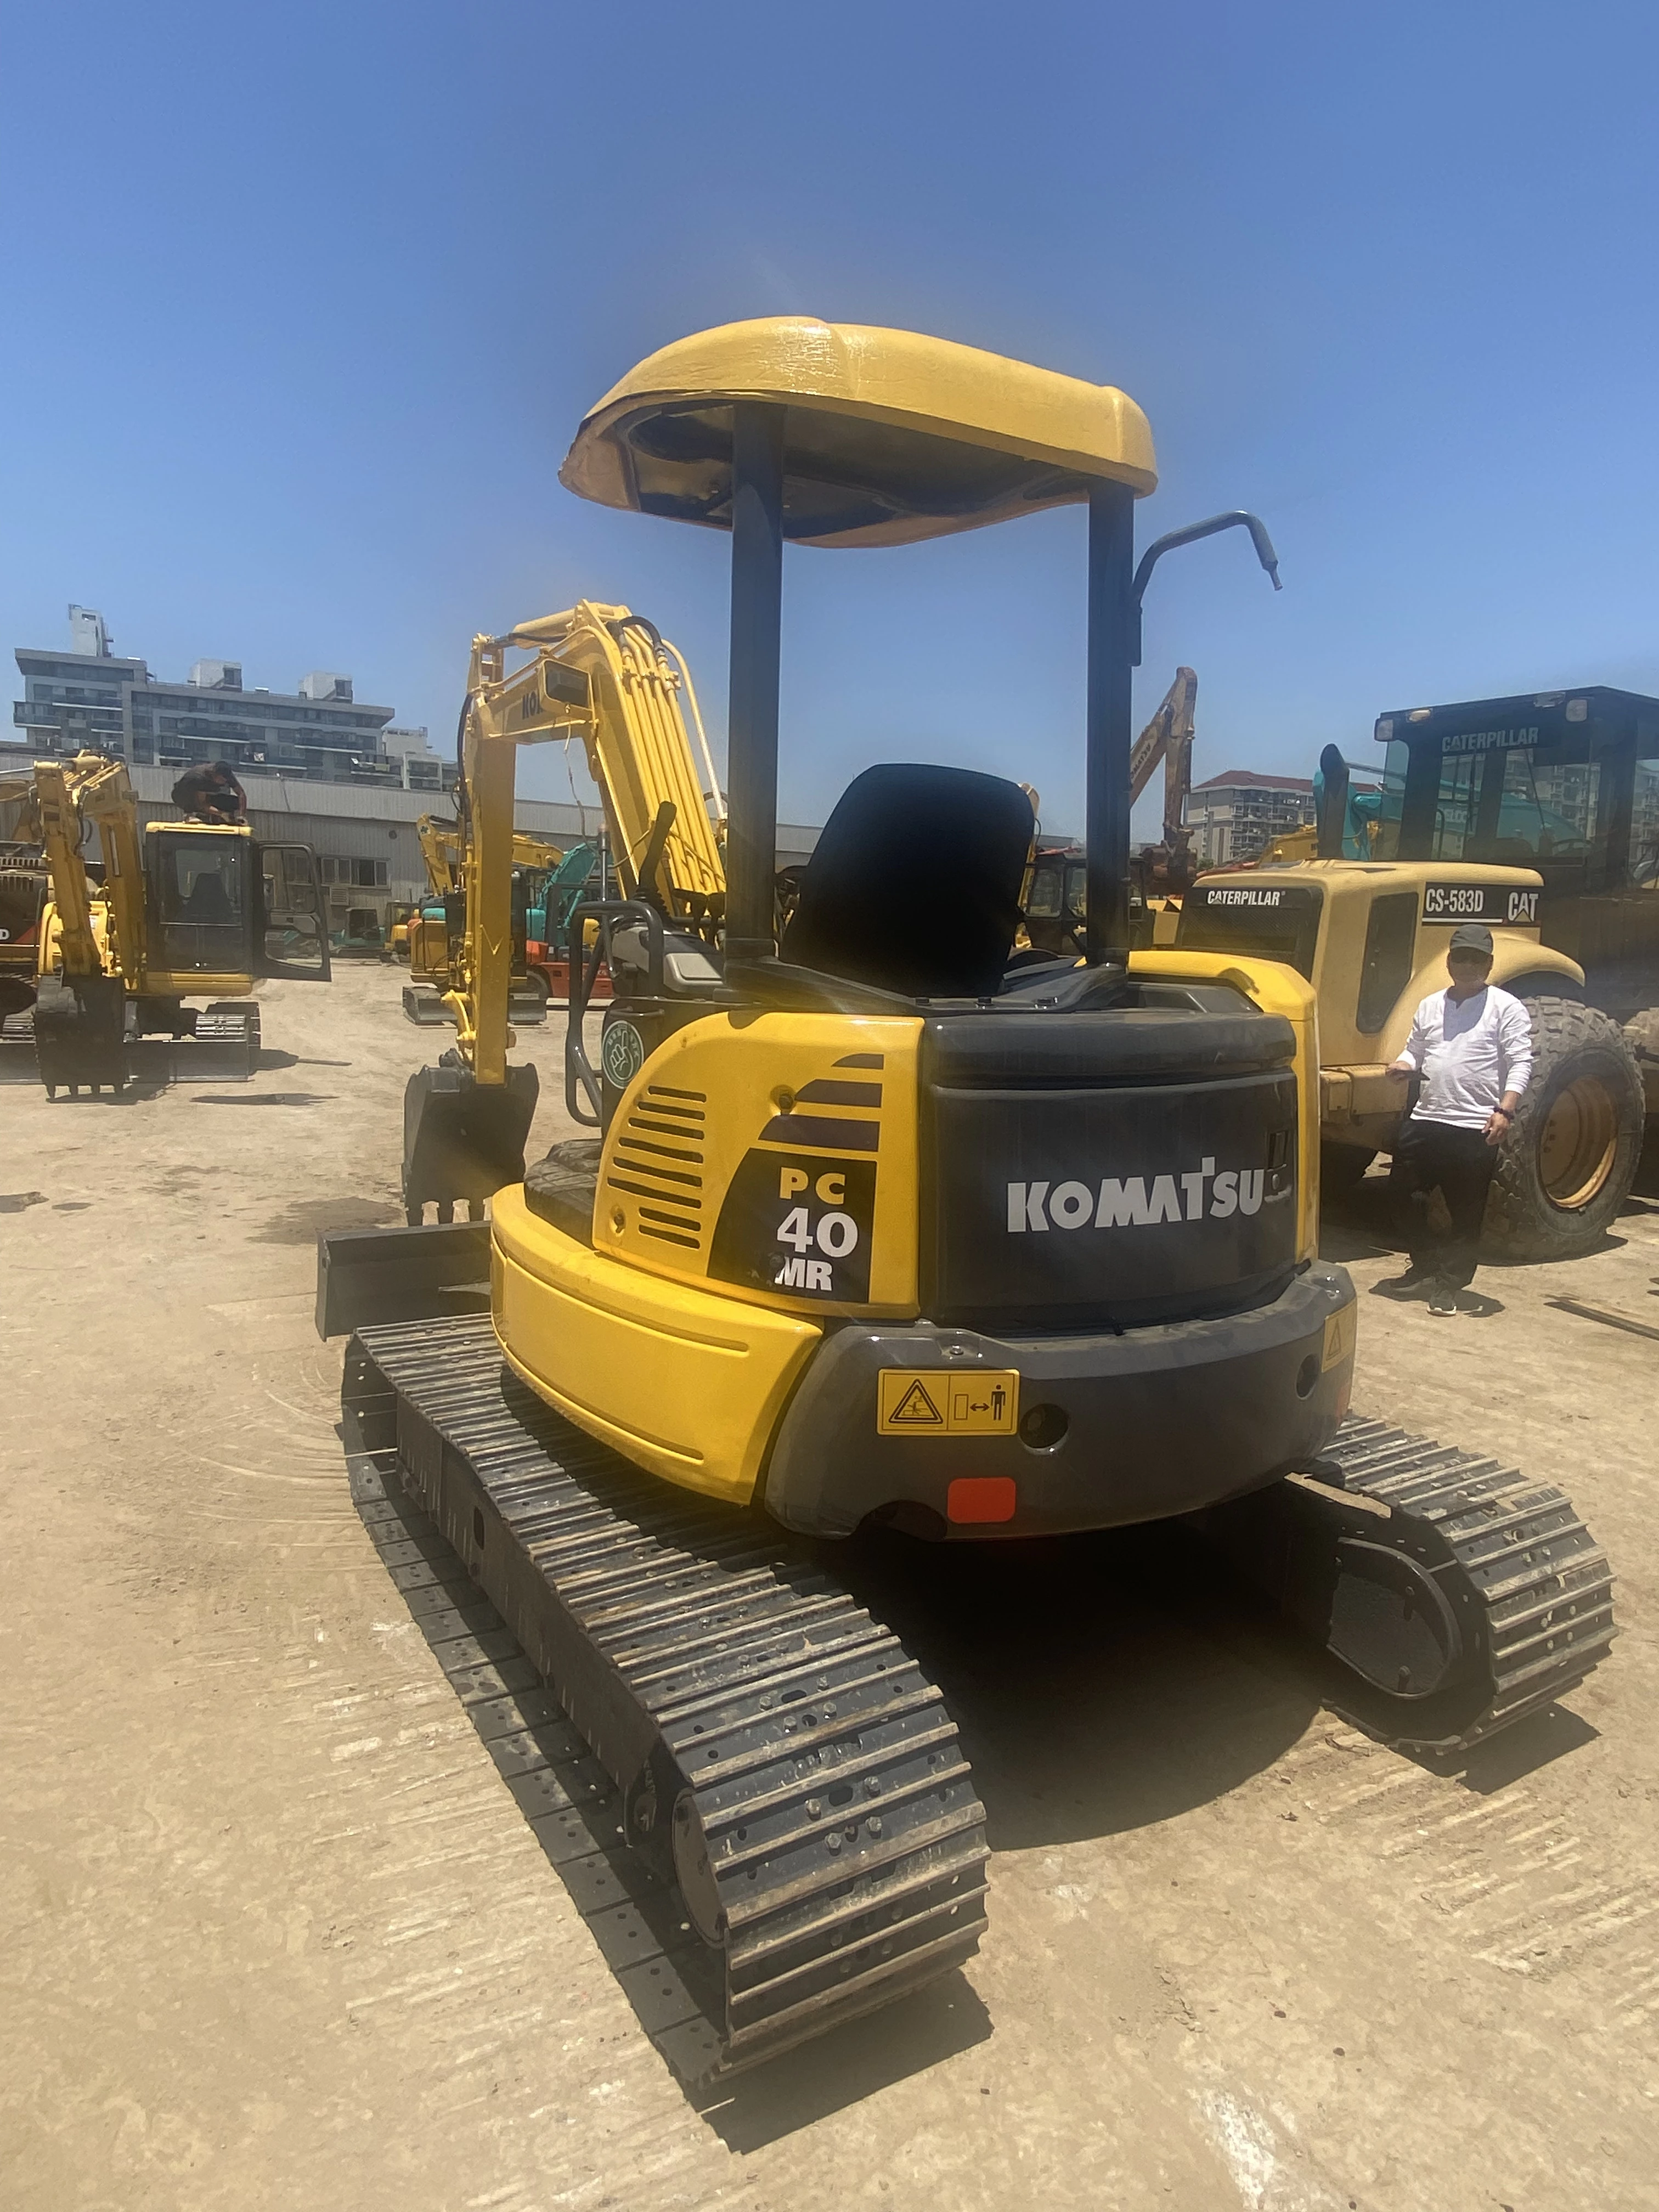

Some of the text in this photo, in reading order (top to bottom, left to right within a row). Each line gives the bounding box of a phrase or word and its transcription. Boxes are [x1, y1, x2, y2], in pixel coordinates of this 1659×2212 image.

[1442, 727, 1538, 752] CATERPILLAR
[1207, 890, 1280, 905] CATERPILLAR
[1426, 888, 1484, 912] CS-583D
[1508, 892, 1539, 922] CAT
[780, 1167, 845, 1205] PC
[1007, 1156, 1265, 1233] KOMATSU
[777, 1207, 859, 1257] 40
[775, 1257, 833, 1291] MR
